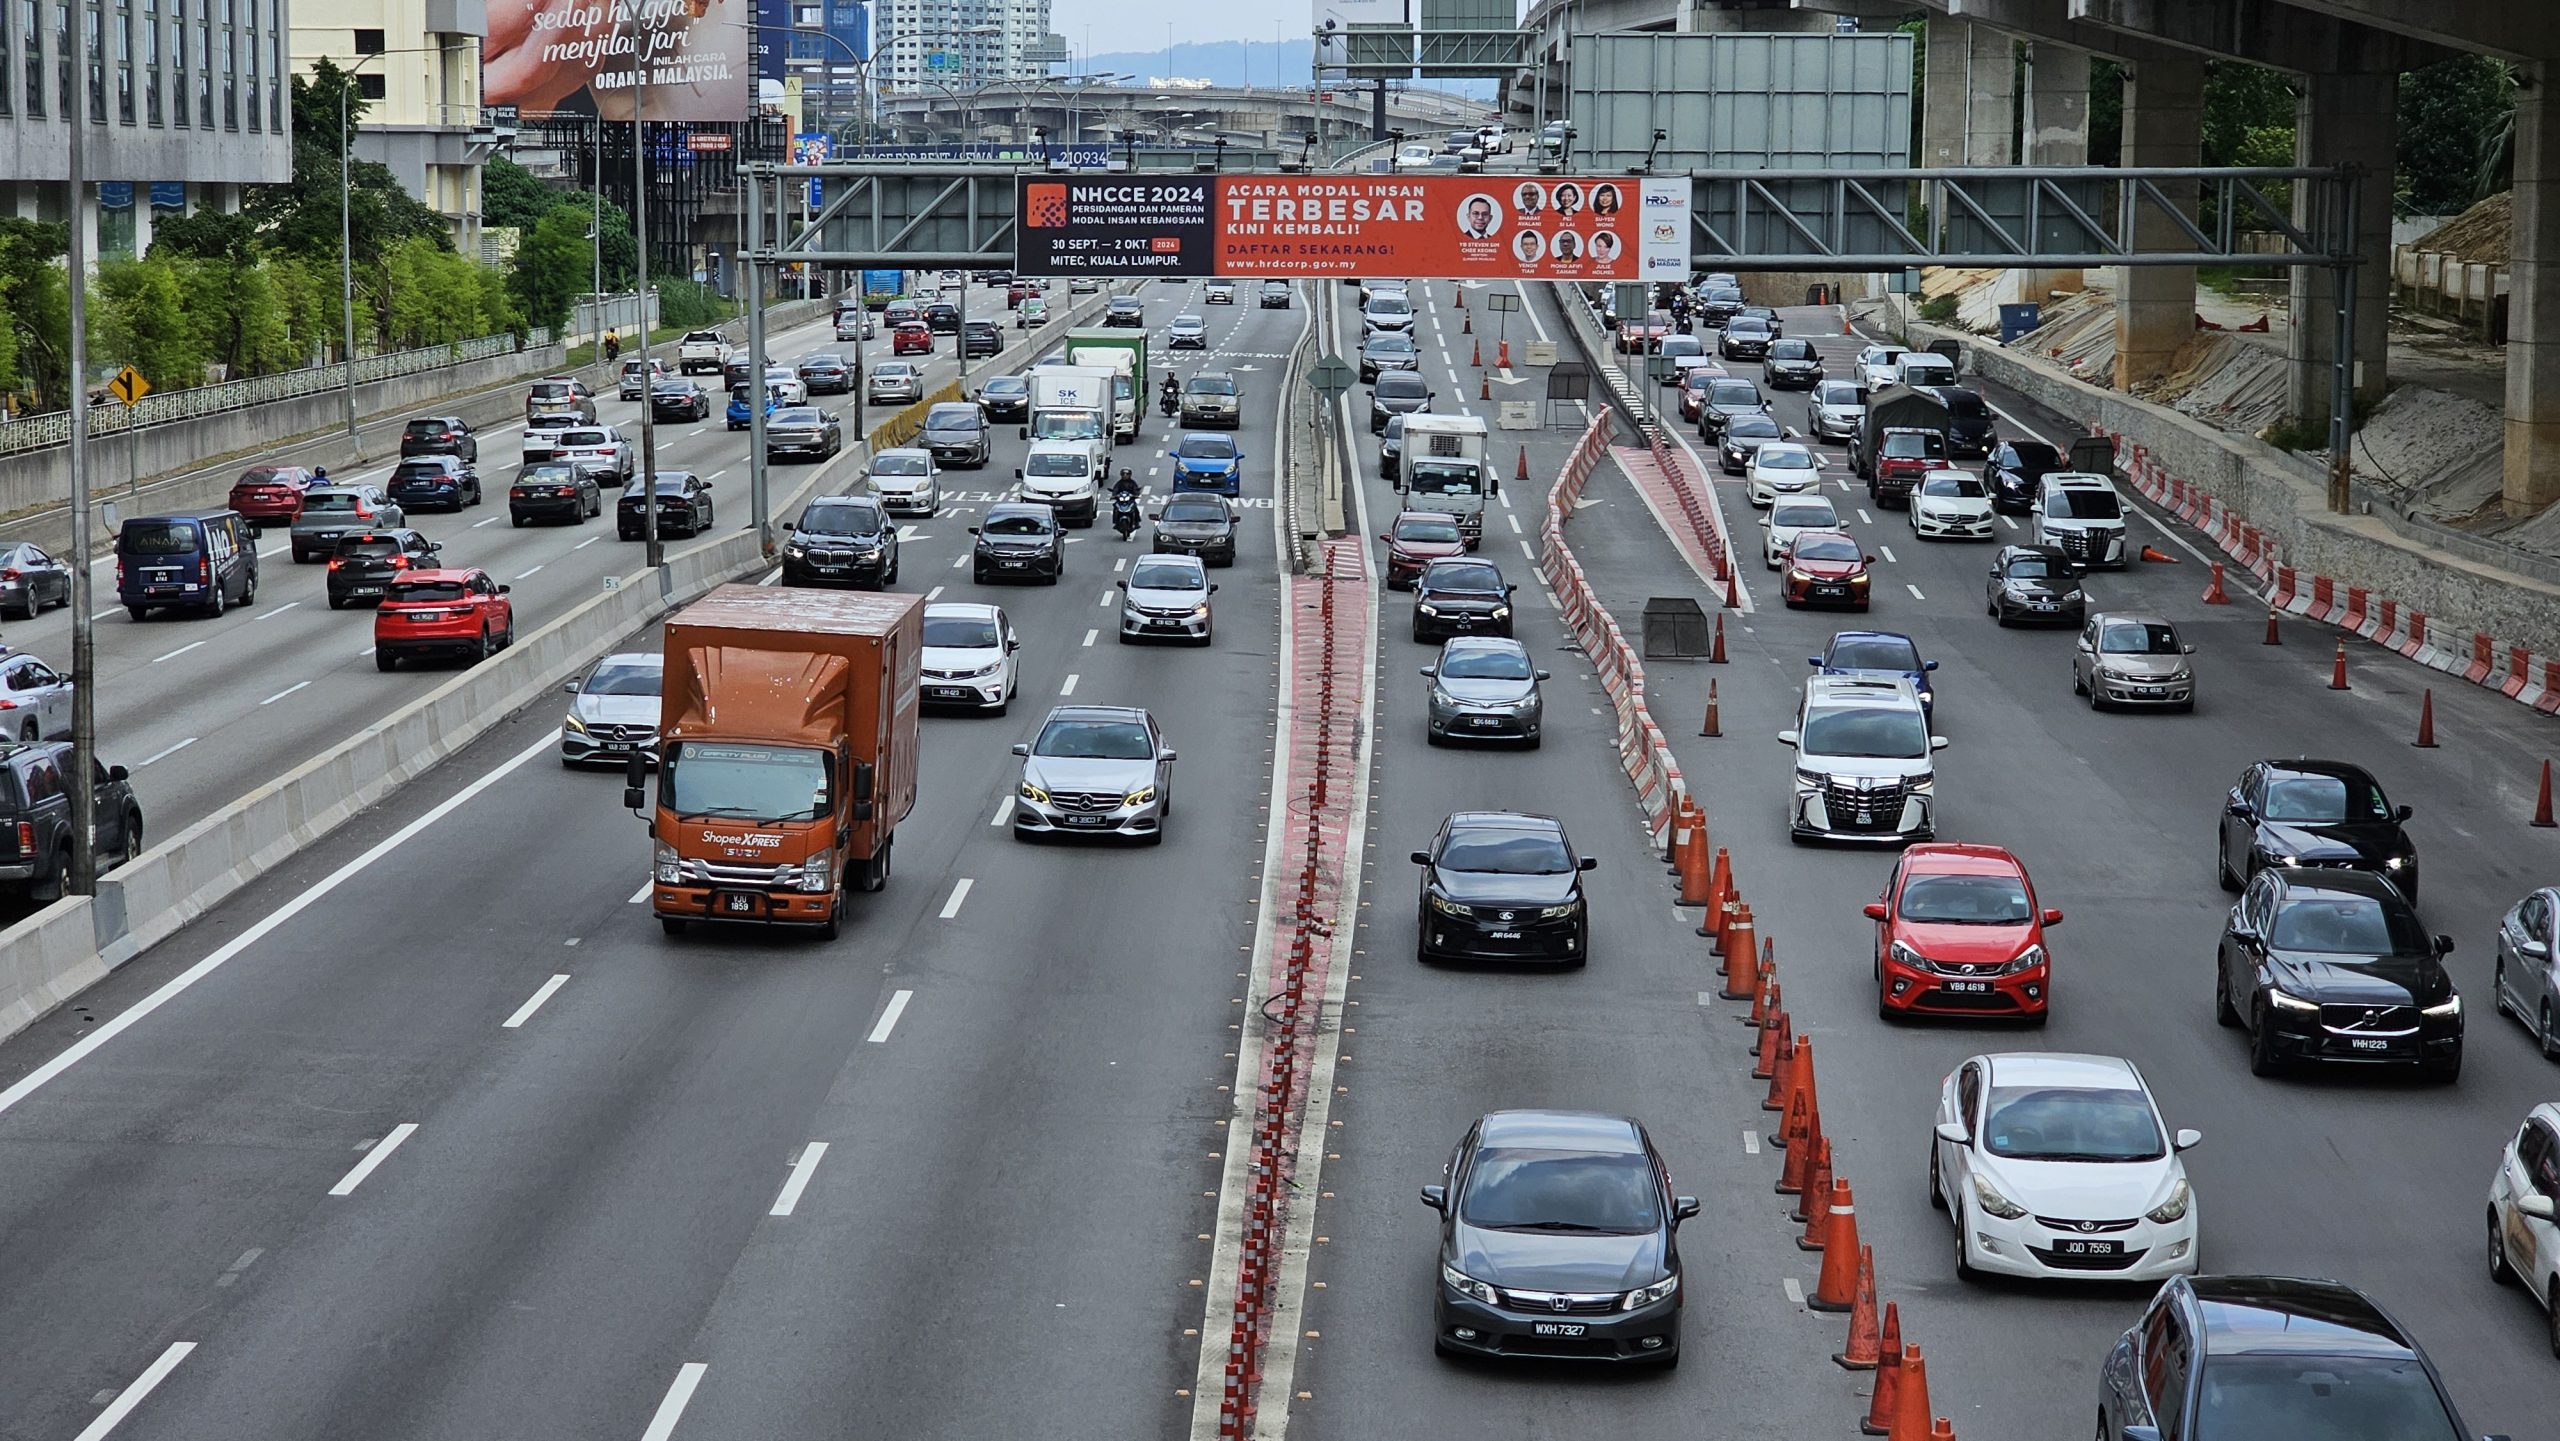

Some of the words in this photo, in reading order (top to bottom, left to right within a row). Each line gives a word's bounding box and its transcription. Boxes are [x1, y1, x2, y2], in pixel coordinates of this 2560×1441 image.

[653, 55, 691, 66] INILAH
[694, 53, 726, 64] CARA
[596, 70, 646, 90] ORANG
[652, 65, 732, 85] MALAYSIA.
[1072, 186, 1146, 202] NHCCE
[1151, 186, 1204, 202] 2024
[1227, 186, 1289, 196] ACARA
[1298, 186, 1360, 196] MODAL
[1368, 186, 1424, 196] INSAN
[1072, 205, 1137, 213] PERSIDANGAN
[1139, 205, 1158, 213] DAN
[1160, 205, 1204, 213] PAMERAN
[1227, 199, 1424, 221] TERBESAR
[1072, 216, 1105, 224] MODAL
[1108, 216, 1138, 224] INSAN
[1140, 216, 1204, 224] KEBANGSAAN
[1227, 224, 1264, 234] KINI
[1273, 224, 1360, 234] KEMBALI!
[1052, 240, 1066, 250] 30
[1068, 240, 1100, 250] SEPT.
[1114, 240, 1122, 250] 2
[1124, 240, 1148, 250] OKT.
[1227, 245, 1291, 254] DAFTAR
[1300, 245, 1395, 254] SEKARANG!
[1050, 256, 1087, 266] MITEC,
[1090, 256, 1128, 266] KUALA
[1131, 256, 1181, 266] LUMPUR.
[1227, 260, 1356, 269] www.hrdcorp.gov.my
[724, 848, 760, 856] ISUZU
[1950, 982, 1966, 990] VBB
[1967, 983, 1985, 992] 4618
[2088, 1243, 2111, 1254] 7559
[1536, 1324, 1557, 1334] WXH
[1558, 1325, 1584, 1335] 7327
